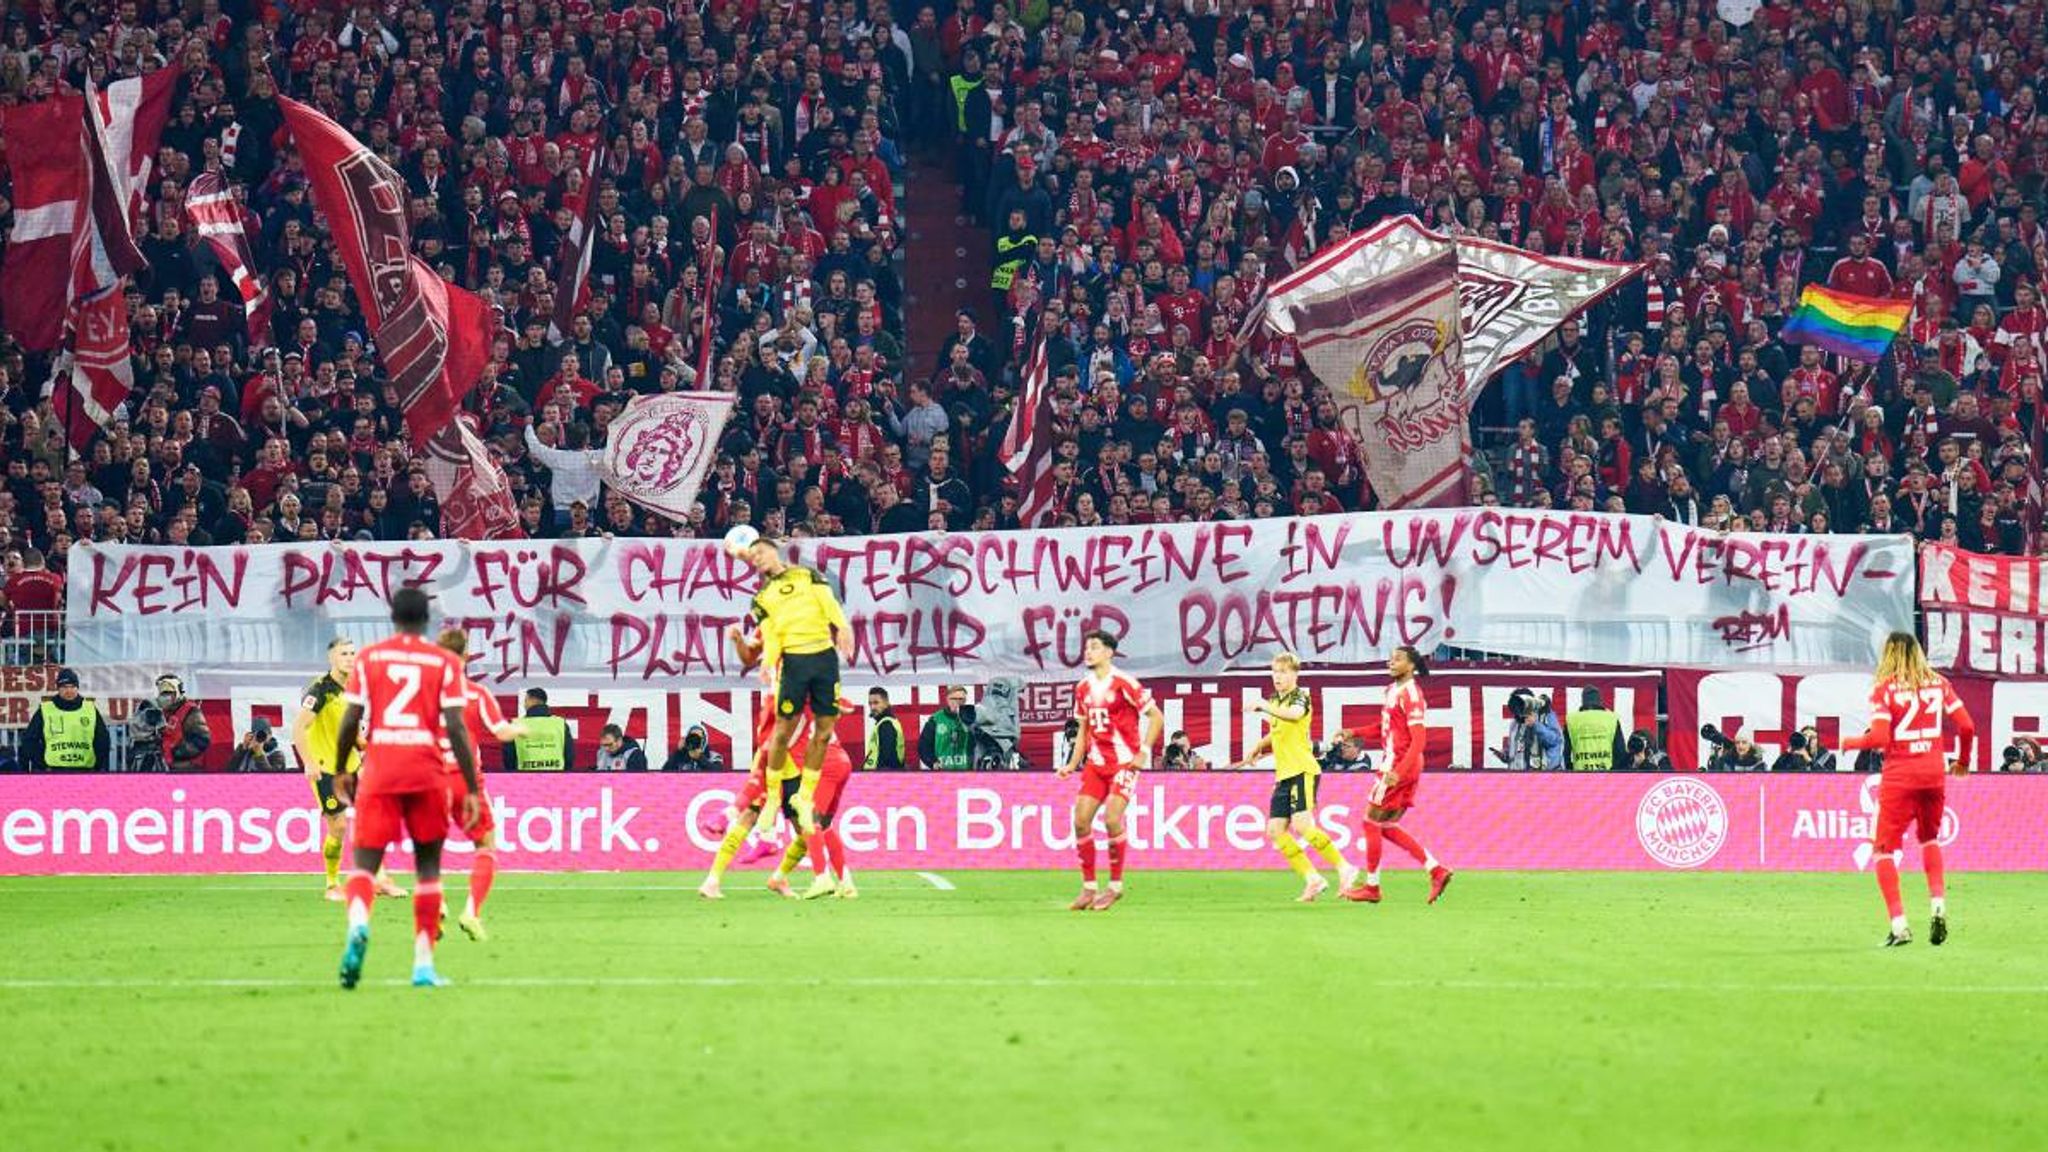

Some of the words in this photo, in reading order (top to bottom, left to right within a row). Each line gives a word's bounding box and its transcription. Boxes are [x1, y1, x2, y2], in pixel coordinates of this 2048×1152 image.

[91, 550, 248, 616] KEIN
[279, 548, 443, 610] PLATZ
[472, 546, 587, 610] FÜR
[620, 524, 1253, 603] CHARTERSCHWEINE
[1280, 521, 1350, 583] IN
[1384, 511, 1641, 575] UNSEREM
[1922, 546, 2048, 616] KEI
[444, 611, 572, 684] EIN
[1179, 574, 1456, 664] BOATENG!
[1926, 611, 2048, 675] VER
[384, 664, 421, 727] 2
[1894, 687, 1942, 740] 23
[685, 789, 926, 856] Gen
[957, 785, 1367, 851] Brustkres.
[1662, 784, 1719, 816] BAYERN
